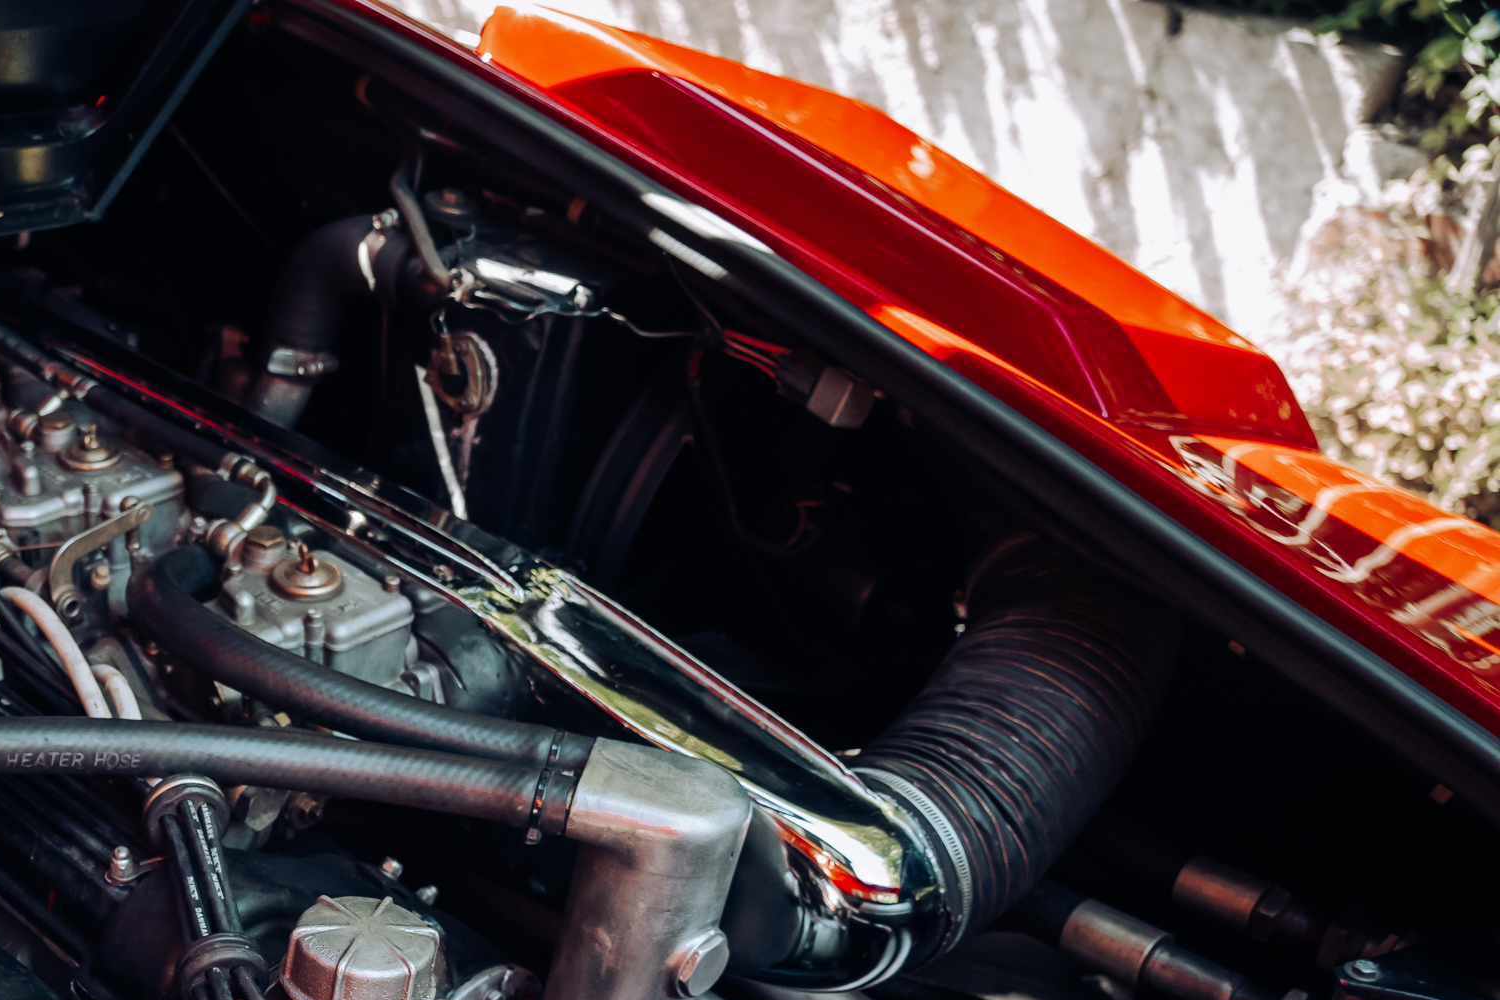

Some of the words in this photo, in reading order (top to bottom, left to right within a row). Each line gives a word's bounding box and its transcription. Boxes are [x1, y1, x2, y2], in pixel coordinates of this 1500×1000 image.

[6, 751, 85, 769] HEATER
[93, 751, 142, 770] HOSE
[196, 828, 214, 866] DANMARK
[211, 872, 225, 901] NKT
[210, 846, 223, 875] NKT
[186, 875, 200, 901] NKT
